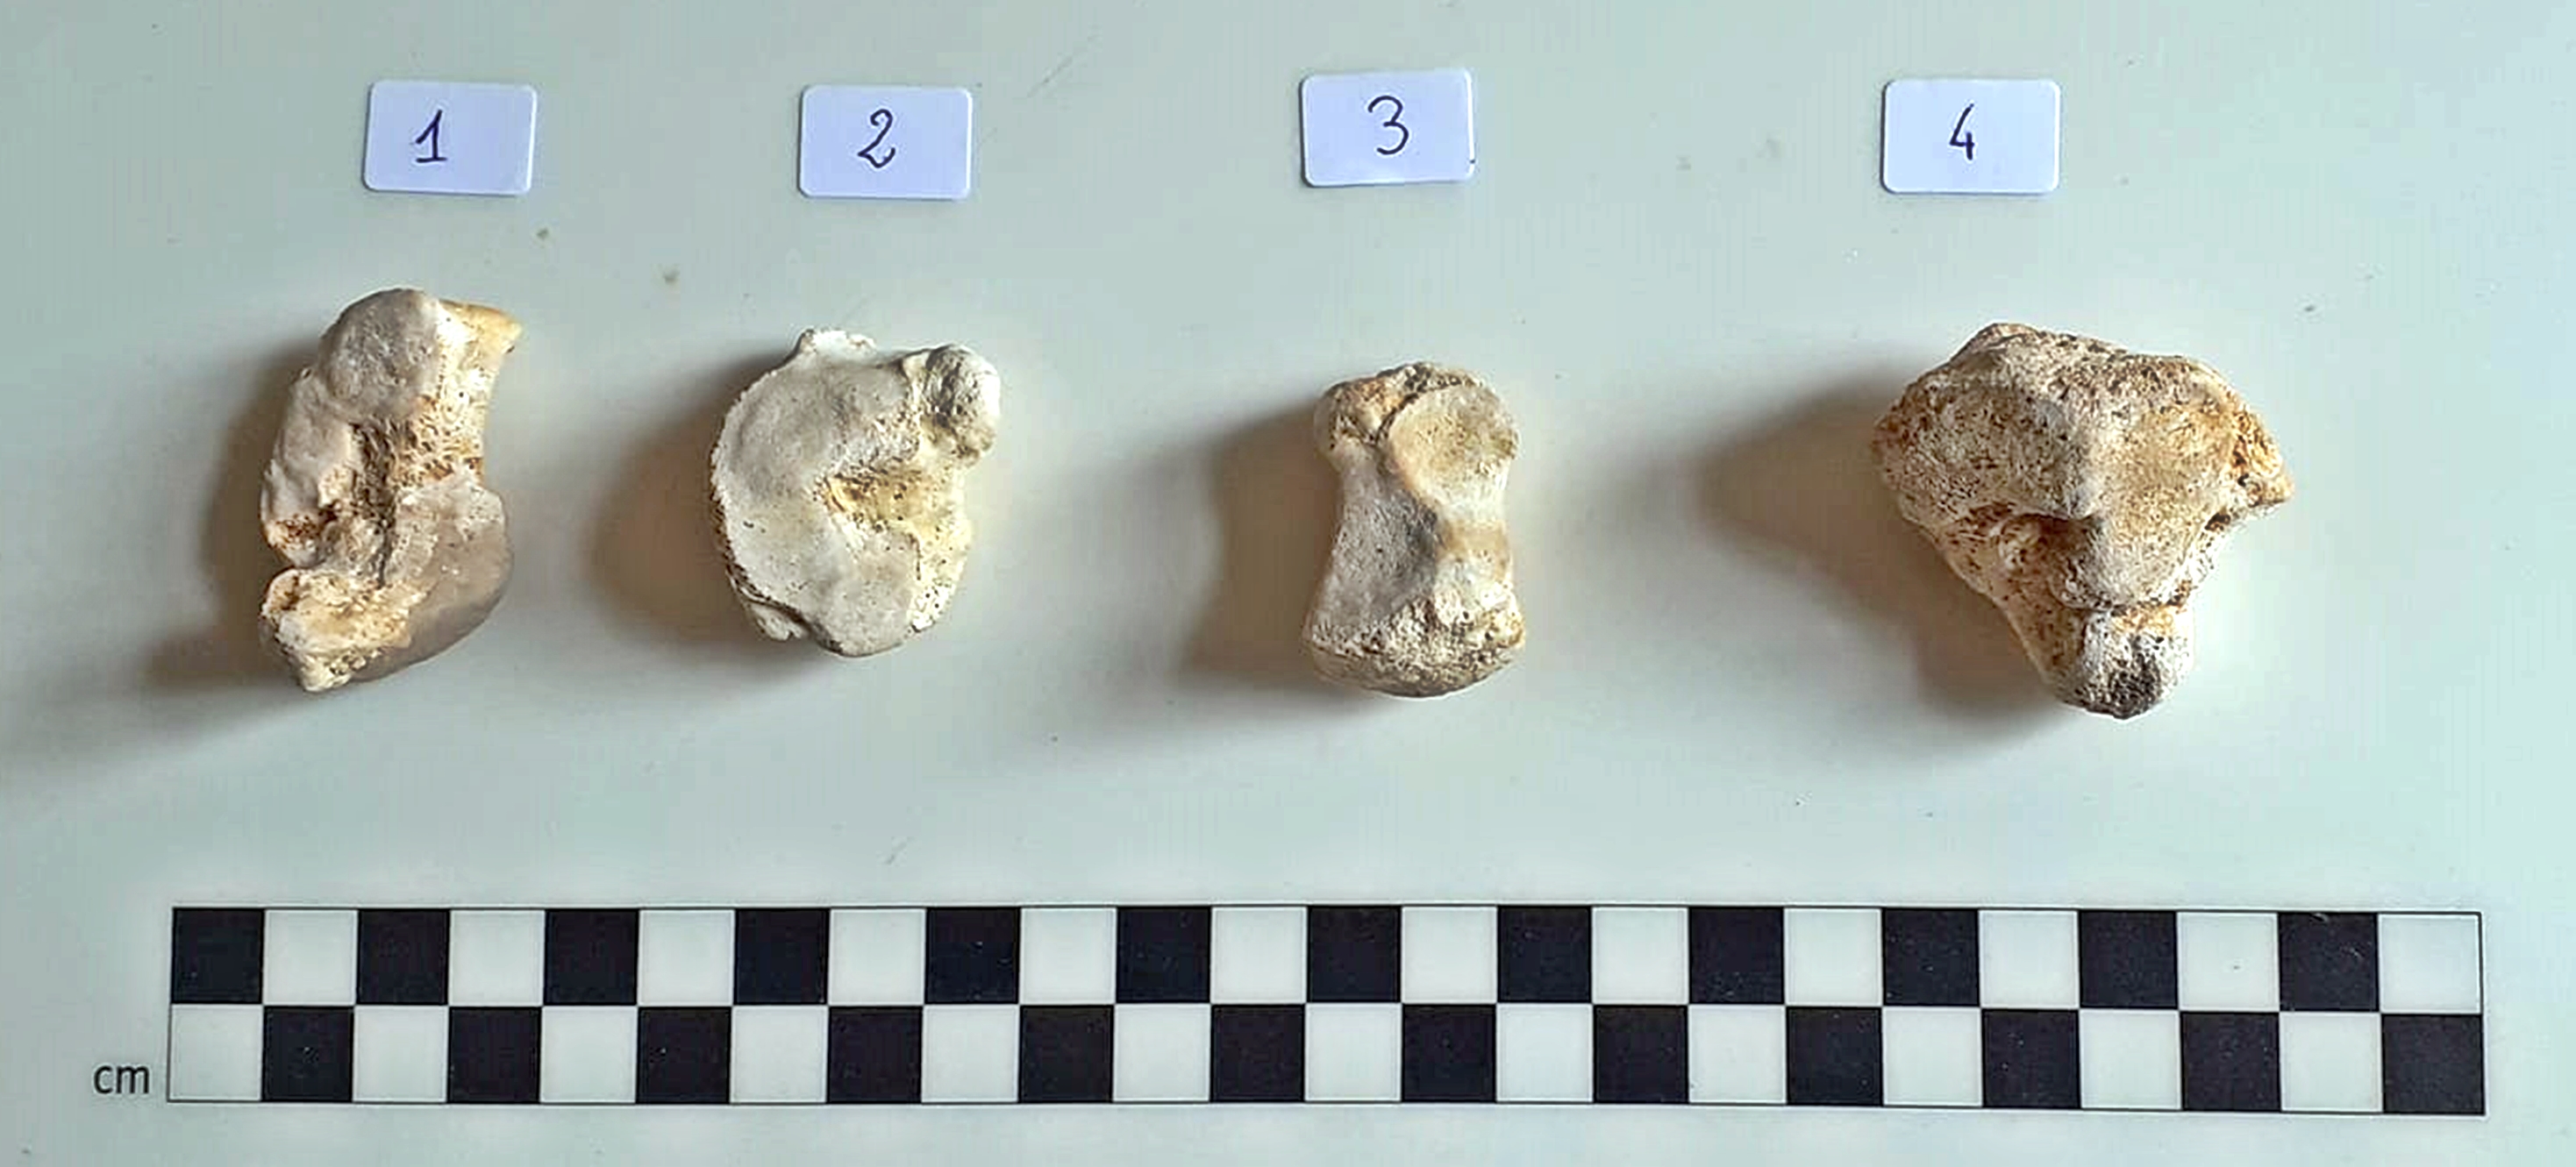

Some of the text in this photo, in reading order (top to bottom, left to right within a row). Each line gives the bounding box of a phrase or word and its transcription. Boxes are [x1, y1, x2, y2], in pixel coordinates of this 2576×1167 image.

[414, 109, 447, 164] 1
[857, 108, 896, 169] 2
[1366, 95, 1409, 155] 3
[1948, 103, 1976, 161] 4
[93, 1064, 150, 1095] cm
